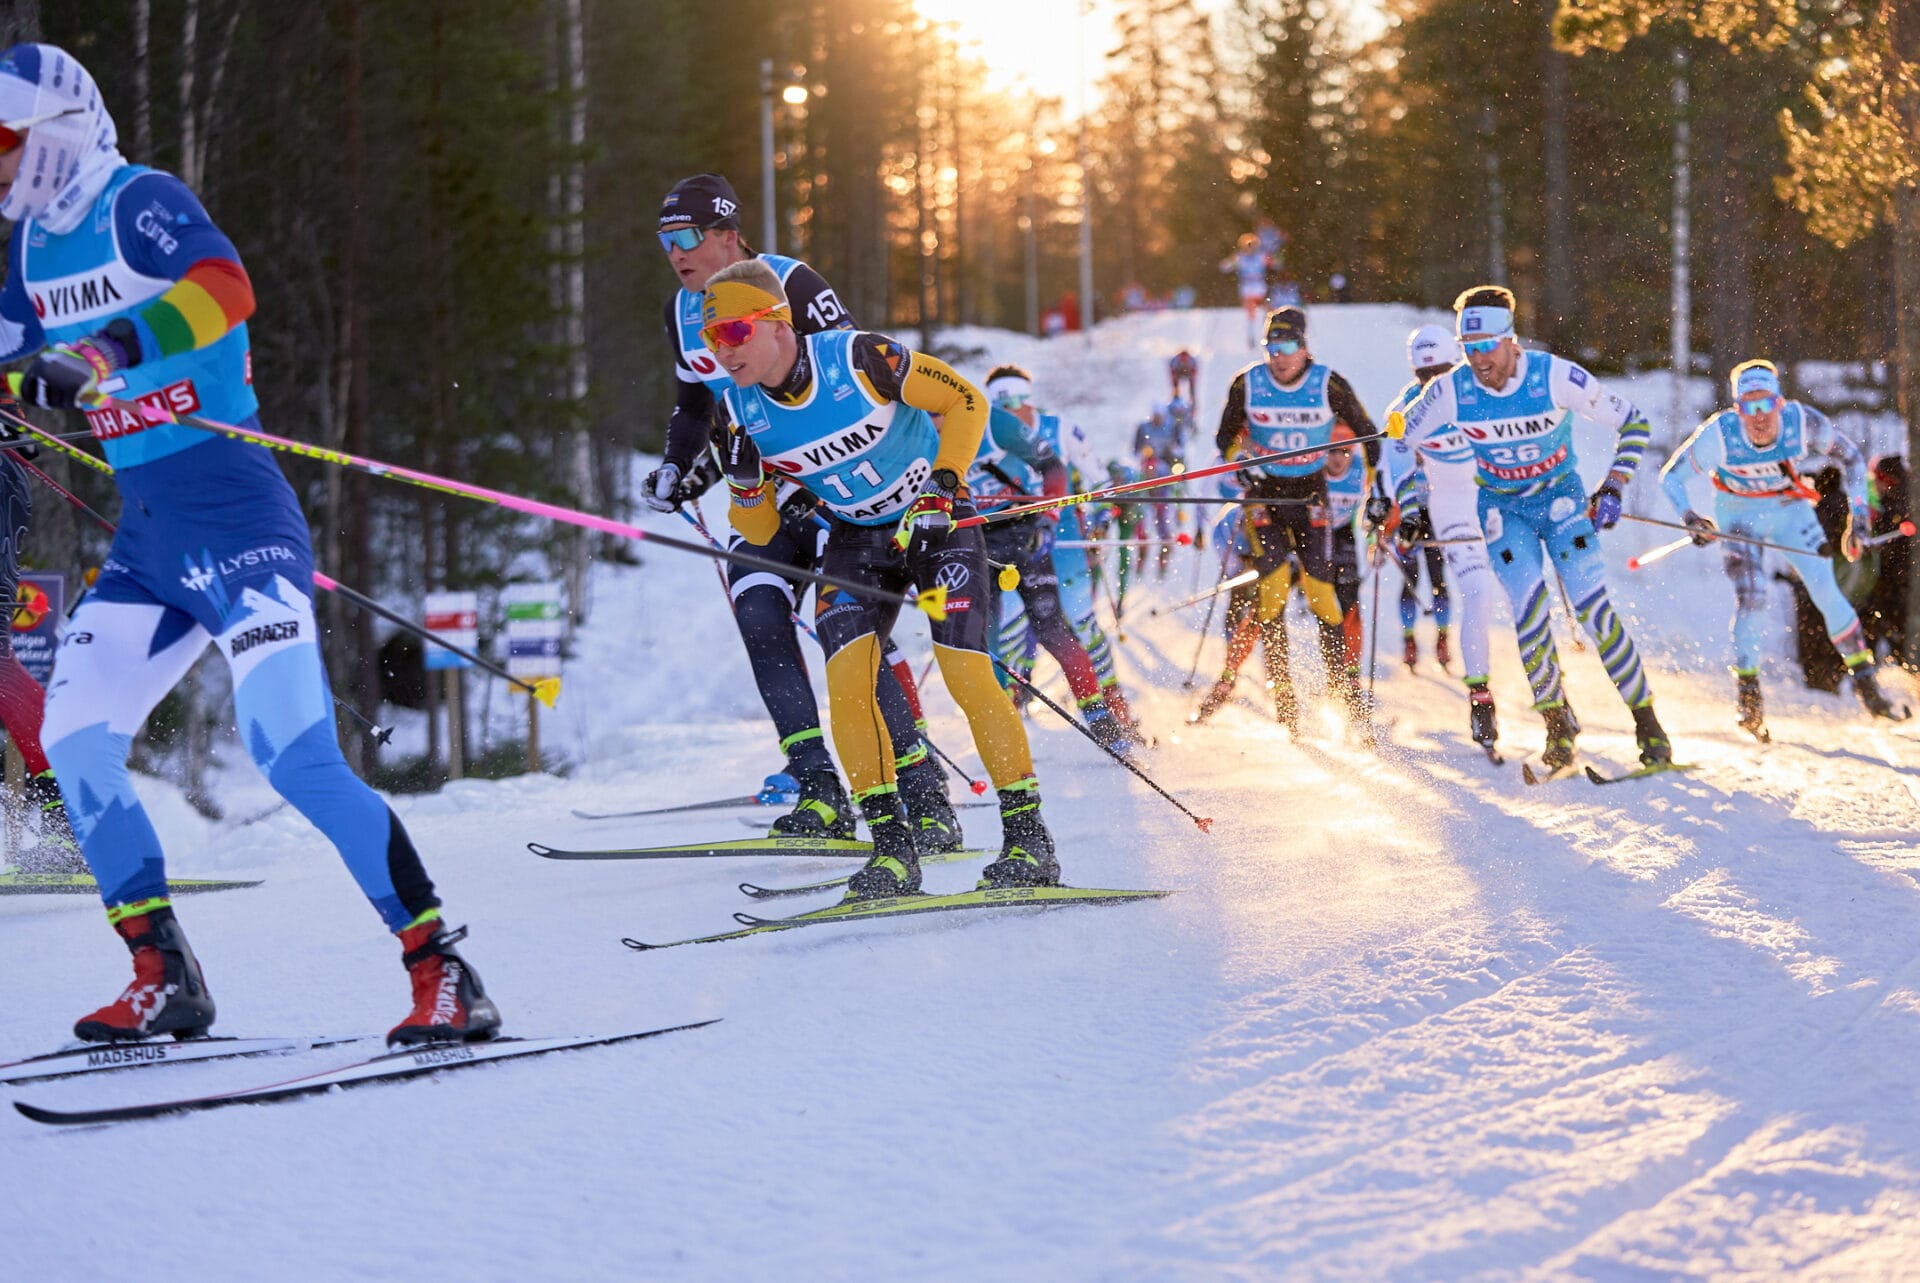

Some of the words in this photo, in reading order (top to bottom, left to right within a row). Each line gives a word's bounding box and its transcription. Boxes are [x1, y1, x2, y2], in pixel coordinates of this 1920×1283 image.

[712, 196, 737, 217] 157
[49, 275, 122, 317] VISMA
[1492, 417, 1555, 439] VISMA
[803, 423, 884, 467] VISMA
[1267, 431, 1308, 450] 40
[1488, 442, 1541, 465] 26
[822, 459, 883, 499] 11
[838, 485, 904, 519] AFT
[219, 546, 297, 576] LYSTRA
[775, 839, 828, 848] FISCHER
[984, 887, 1035, 901] FISCHER
[87, 1047, 167, 1067] MADSHUS
[413, 1047, 475, 1065] MADSHUS
